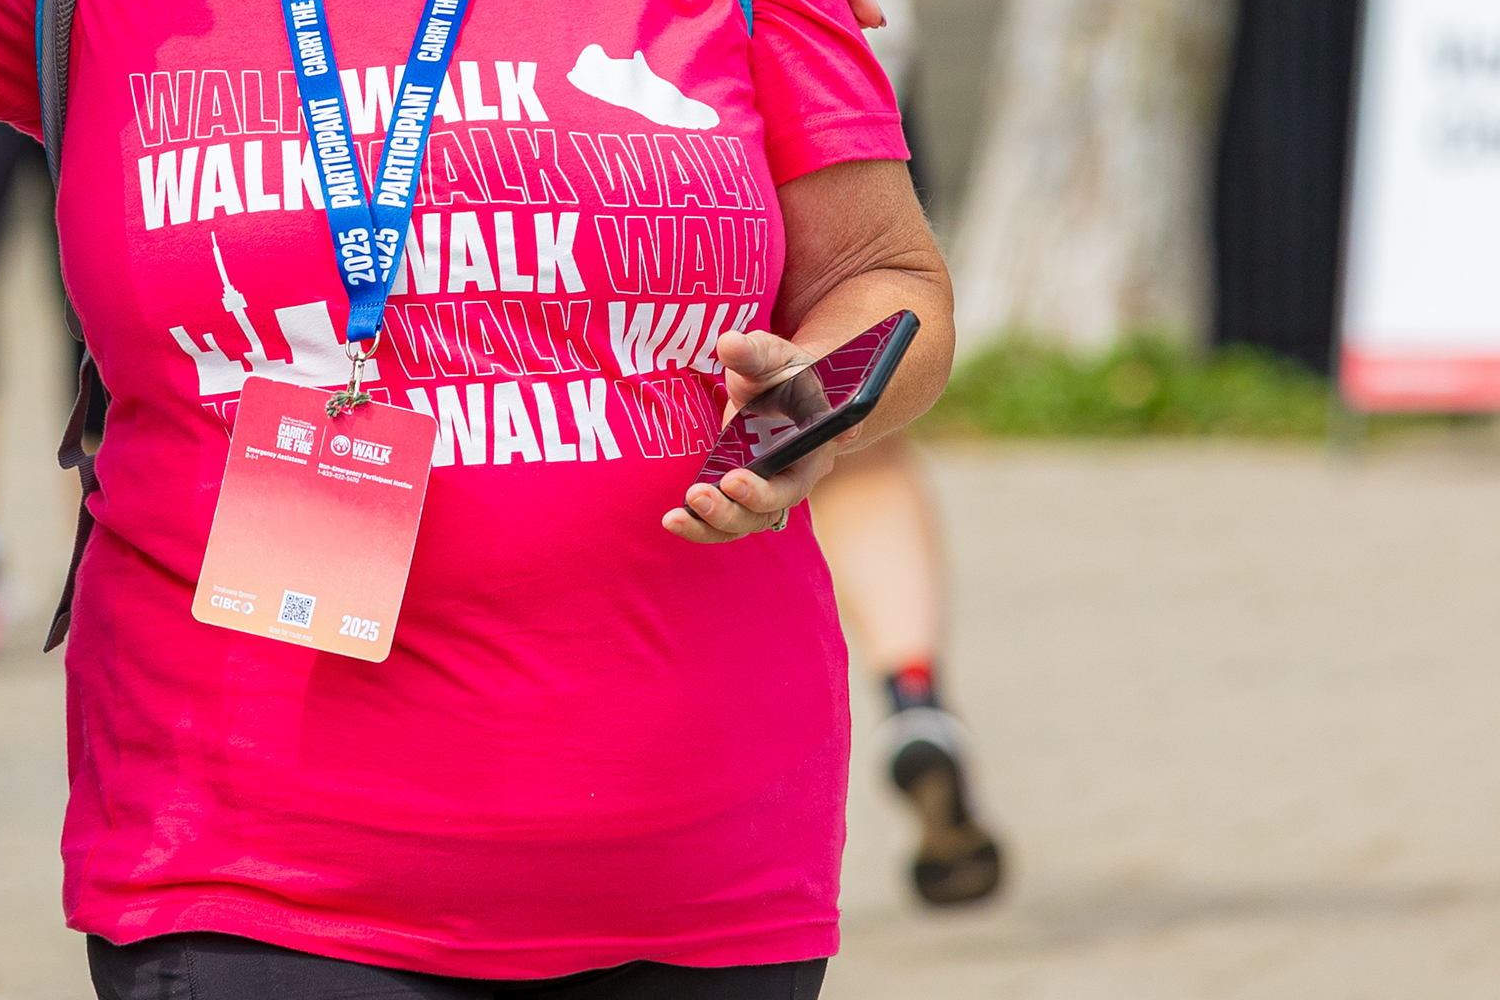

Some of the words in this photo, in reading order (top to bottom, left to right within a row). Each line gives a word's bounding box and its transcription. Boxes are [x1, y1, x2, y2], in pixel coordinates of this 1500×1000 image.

[292, 0, 318, 30] THE
[296, 30, 328, 77] CARRY
[417, 17, 454, 62] CARRY
[308, 98, 361, 209] PARTICIPANT
[377, 83, 434, 208] PARTICIPANT
[138, 140, 325, 230] WALK
[569, 132, 765, 210] WALK
[338, 227, 377, 286] 2025
[388, 211, 586, 295] WALK
[594, 215, 767, 296] WALK
[383, 300, 601, 380] WALK
[278, 424, 306, 439] CARRY
[406, 378, 622, 467] WALK
[246, 446, 277, 459] Emergency
[277, 453, 308, 465] Assistance
[276, 436, 294, 451] THE
[293, 439, 313, 456] FIRE
[352, 442, 392, 464] WALK
[318, 462, 363, 478] Non-Emergency
[362, 472, 393, 485] Participant
[210, 594, 241, 612] CIBC
[338, 614, 381, 642] 2025
